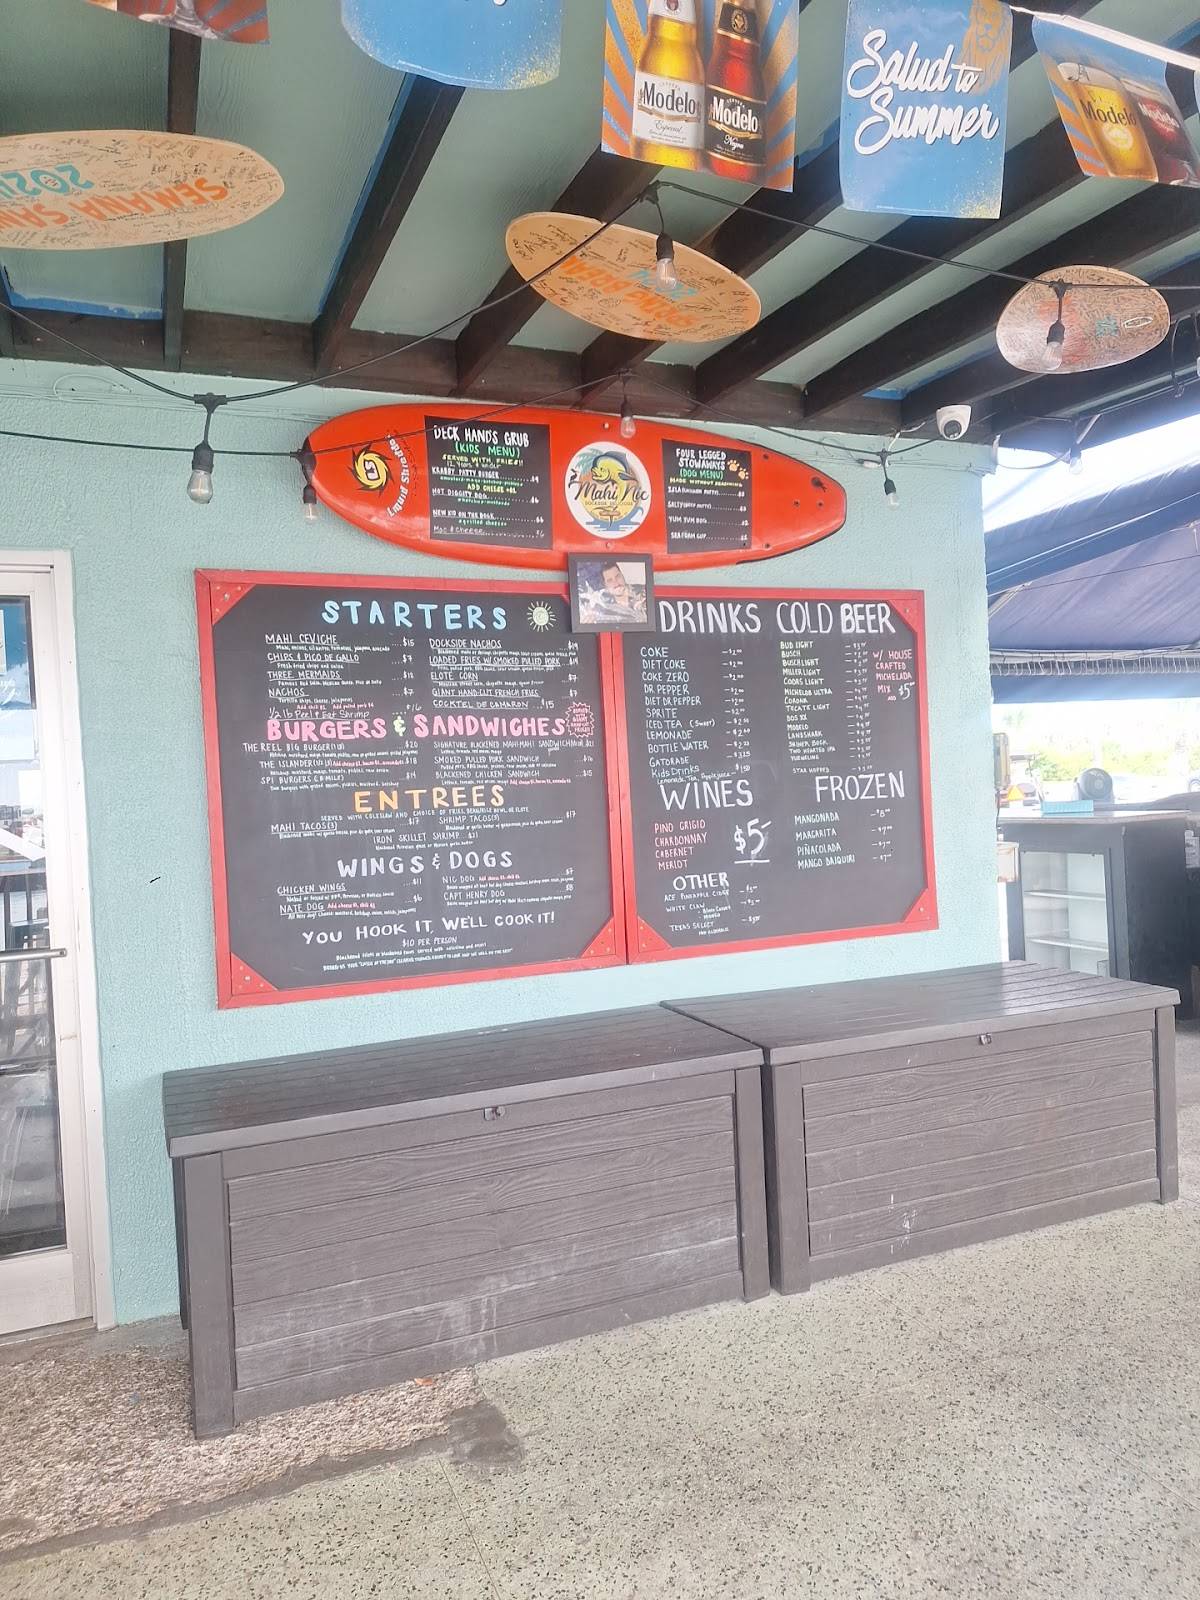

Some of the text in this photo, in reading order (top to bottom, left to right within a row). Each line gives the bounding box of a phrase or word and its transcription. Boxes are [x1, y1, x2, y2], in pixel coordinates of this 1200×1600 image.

[847, 28, 983, 98] Salud to
[644, 81, 697, 115] Modelo
[712, 96, 759, 132] Modelo
[1079, 98, 1137, 126] Modelo
[854, 86, 1000, 155] Summer
[69, 177, 228, 221] SEMANA
[434, 425, 460, 441] DECK
[504, 432, 529, 447] GRUB
[455, 441, 520, 458] (KIDS MENU)
[676, 448, 726, 460] FOUR LEGGED
[679, 458, 725, 470] STOWAWAYS
[680, 468, 723, 480] (DOG MENU)
[568, 480, 649, 502] Mahi Nic
[386, 484, 409, 518] Liquid
[322, 600, 508, 630] STARTERS
[659, 600, 761, 633] DRINKS
[776, 602, 896, 633] COLD BEER
[265, 633, 337, 645] MAHI CEVICHE
[429, 638, 502, 649] DOCKSIDE NACHOS
[780, 641, 793, 649] BUD
[267, 653, 293, 661] CHIPS
[336, 654, 359, 662] GALLO
[640, 647, 669, 657] COKE
[781, 650, 801, 658] BUSCH
[888, 649, 912, 659] HOUSE
[429, 656, 560, 665] LOADED FRIES SMOKED PULLED PORK
[642, 660, 686, 669] DIET COKE
[875, 662, 906, 670] CRAFTED
[267, 671, 341, 679] THREE MERMAIDS
[431, 672, 478, 681] ELOTE CORN
[642, 672, 689, 682] COKE ZERO
[876, 672, 912, 680] MICHELADA
[269, 688, 305, 697] NACHOS
[432, 689, 455, 697] GIANT
[495, 689, 519, 697] FRENCH
[644, 684, 689, 695] DR PEPPER
[878, 685, 891, 693] MIX
[433, 700, 473, 708] COCKTEL
[645, 696, 701, 706] DIET PEPPER
[784, 696, 808, 704] CORONA
[340, 710, 370, 719] Shrimp
[646, 708, 677, 719] SPRITE
[267, 718, 387, 742] BURGERS
[393, 716, 406, 736] &
[413, 713, 566, 740] SANDWICHES
[646, 720, 682, 729] ICED TEA
[646, 730, 693, 740] LEMONADE
[243, 743, 300, 753] THE REEL BIG
[434, 741, 467, 749] SIGNATURE
[648, 740, 709, 753] BOTTLE WATER
[259, 760, 275, 769] THE
[434, 755, 539, 764] SMOKED PULLED SANDWICH
[649, 756, 689, 767] GATORADE
[651, 765, 699, 778] Kids Drinks
[279, 775, 312, 784] BURGERS
[815, 770, 905, 802] FROZEN
[354, 786, 504, 813] ENTREES
[660, 779, 753, 810] WINES
[439, 816, 466, 825] SHRIMP
[795, 812, 840, 824] MANGONADA
[271, 821, 338, 832] MAHI TACOS(3)
[654, 823, 673, 834] PINO
[679, 819, 706, 831] GRIGIO
[373, 835, 392, 844] IRON
[398, 833, 427, 842] SKILLET
[433, 832, 460, 840] SHRIMP
[655, 832, 707, 847] CHARDONNAY
[796, 828, 837, 841] MARGARITA
[655, 847, 693, 858] CABERNET
[337, 856, 424, 878] WINGS
[450, 851, 512, 869] DOGS
[658, 860, 688, 870] MERLOT
[798, 854, 855, 869] MANGO DAIQUIRI
[673, 872, 729, 890] OTHER
[277, 882, 346, 894] CHICKEN WINGS
[444, 892, 463, 901] CAPT
[466, 890, 488, 899] HENRY
[491, 889, 505, 897] DOG
[280, 904, 303, 913] NATE
[306, 903, 324, 911] DOG
[302, 931, 343, 944] YOU
[356, 923, 407, 940] HOOK
[442, 916, 488, 930] WE'LL
[494, 914, 534, 926] COOK
[538, 911, 555, 923] IT!
[417, 936, 457, 946] PER PERSON
